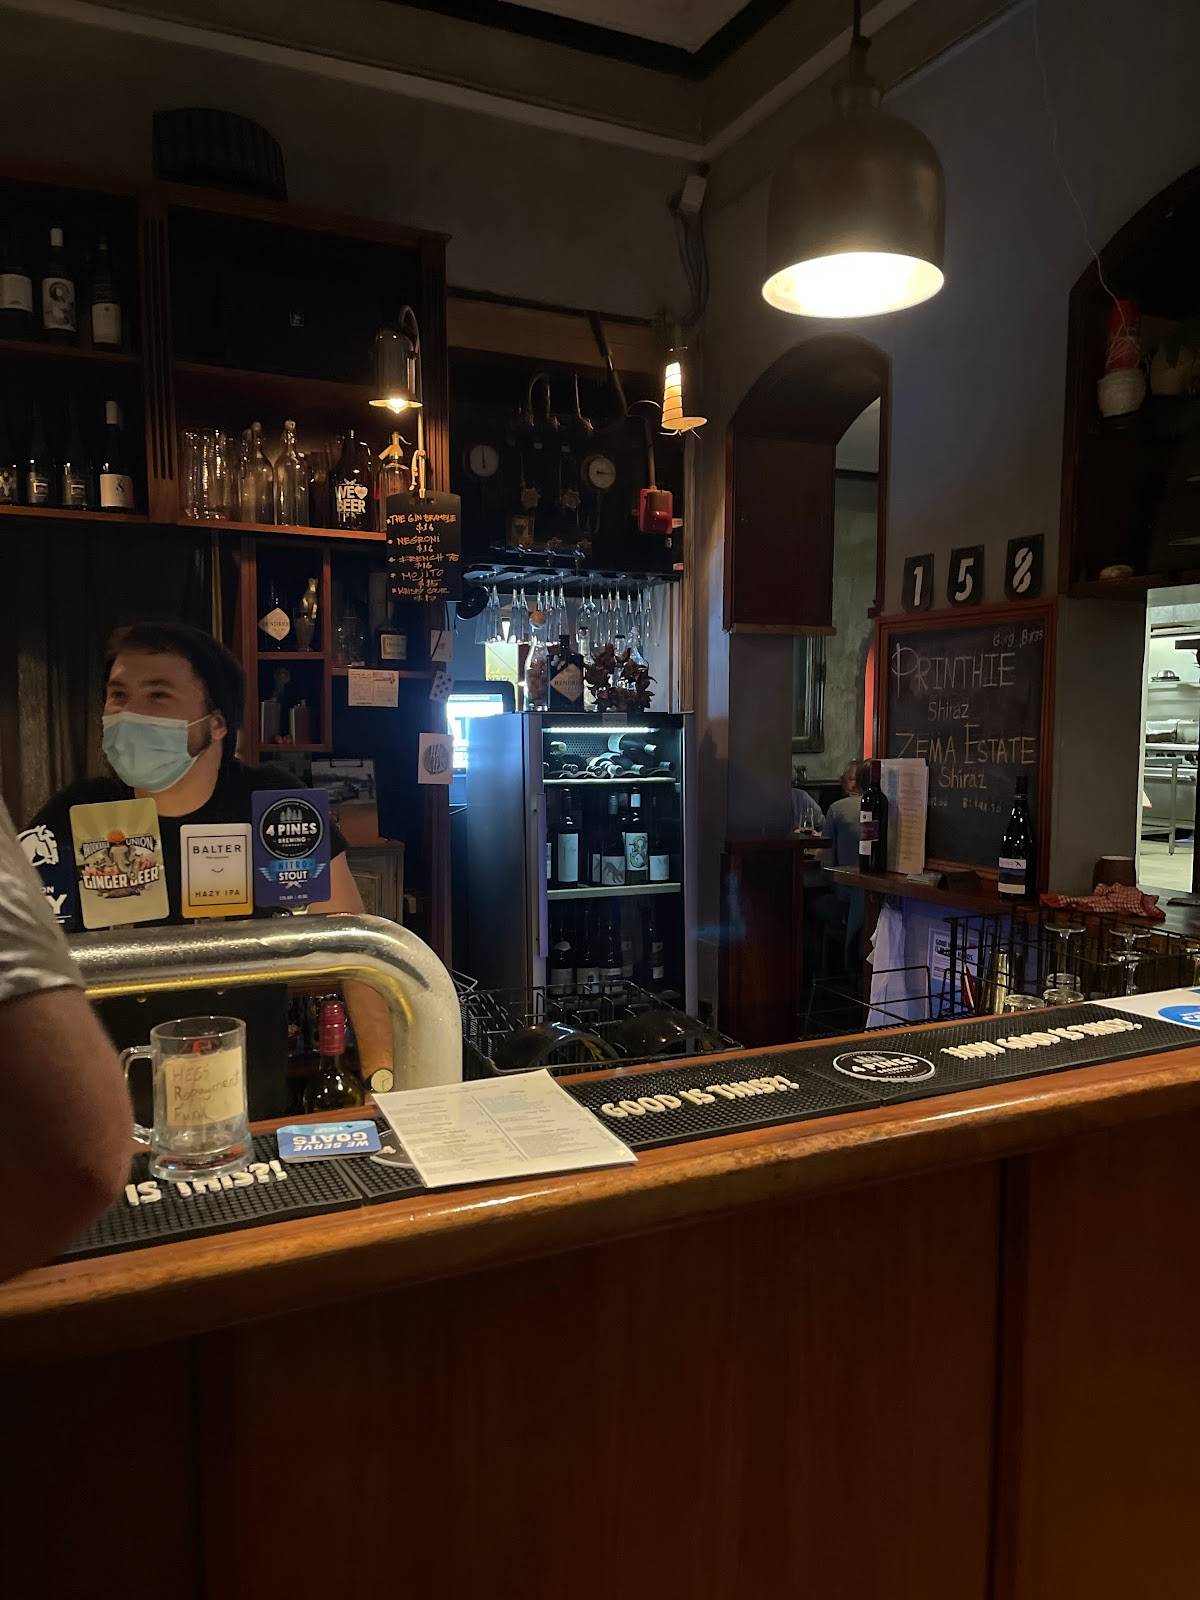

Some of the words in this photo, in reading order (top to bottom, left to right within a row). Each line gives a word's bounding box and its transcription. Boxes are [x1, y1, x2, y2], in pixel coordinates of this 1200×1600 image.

[335, 485, 355, 499] WE
[336, 500, 366, 513] BEER
[389, 515, 406, 525] THE
[407, 513, 422, 523] GIN
[401, 569, 444, 581] MOJITO
[955, 558, 974, 601] 5
[891, 643, 1016, 697] PRINTHIE
[927, 701, 969, 721] Shiraz
[896, 733, 956, 765] ZEMA
[963, 724, 1037, 765] ESTATE
[938, 766, 987, 790] Shiraz
[265, 824, 276, 837] 4
[277, 822, 318, 836] PINES
[125, 836, 154, 851] UNION
[193, 845, 241, 854] BALTER
[277, 860, 308, 870] NITRO
[84, 874, 128, 889] GINGER
[278, 871, 308, 881] STOUT
[194, 890, 221, 898] HAZY
[225, 889, 241, 897] IPA
[862, 1056, 918, 1071] PINES
[601, 1094, 683, 1119] GOOD
[679, 1084, 716, 1106] IS
[293, 1142, 342, 1152] SERVE
[347, 1140, 369, 1149] WE
[124, 1180, 162, 1206] IS
